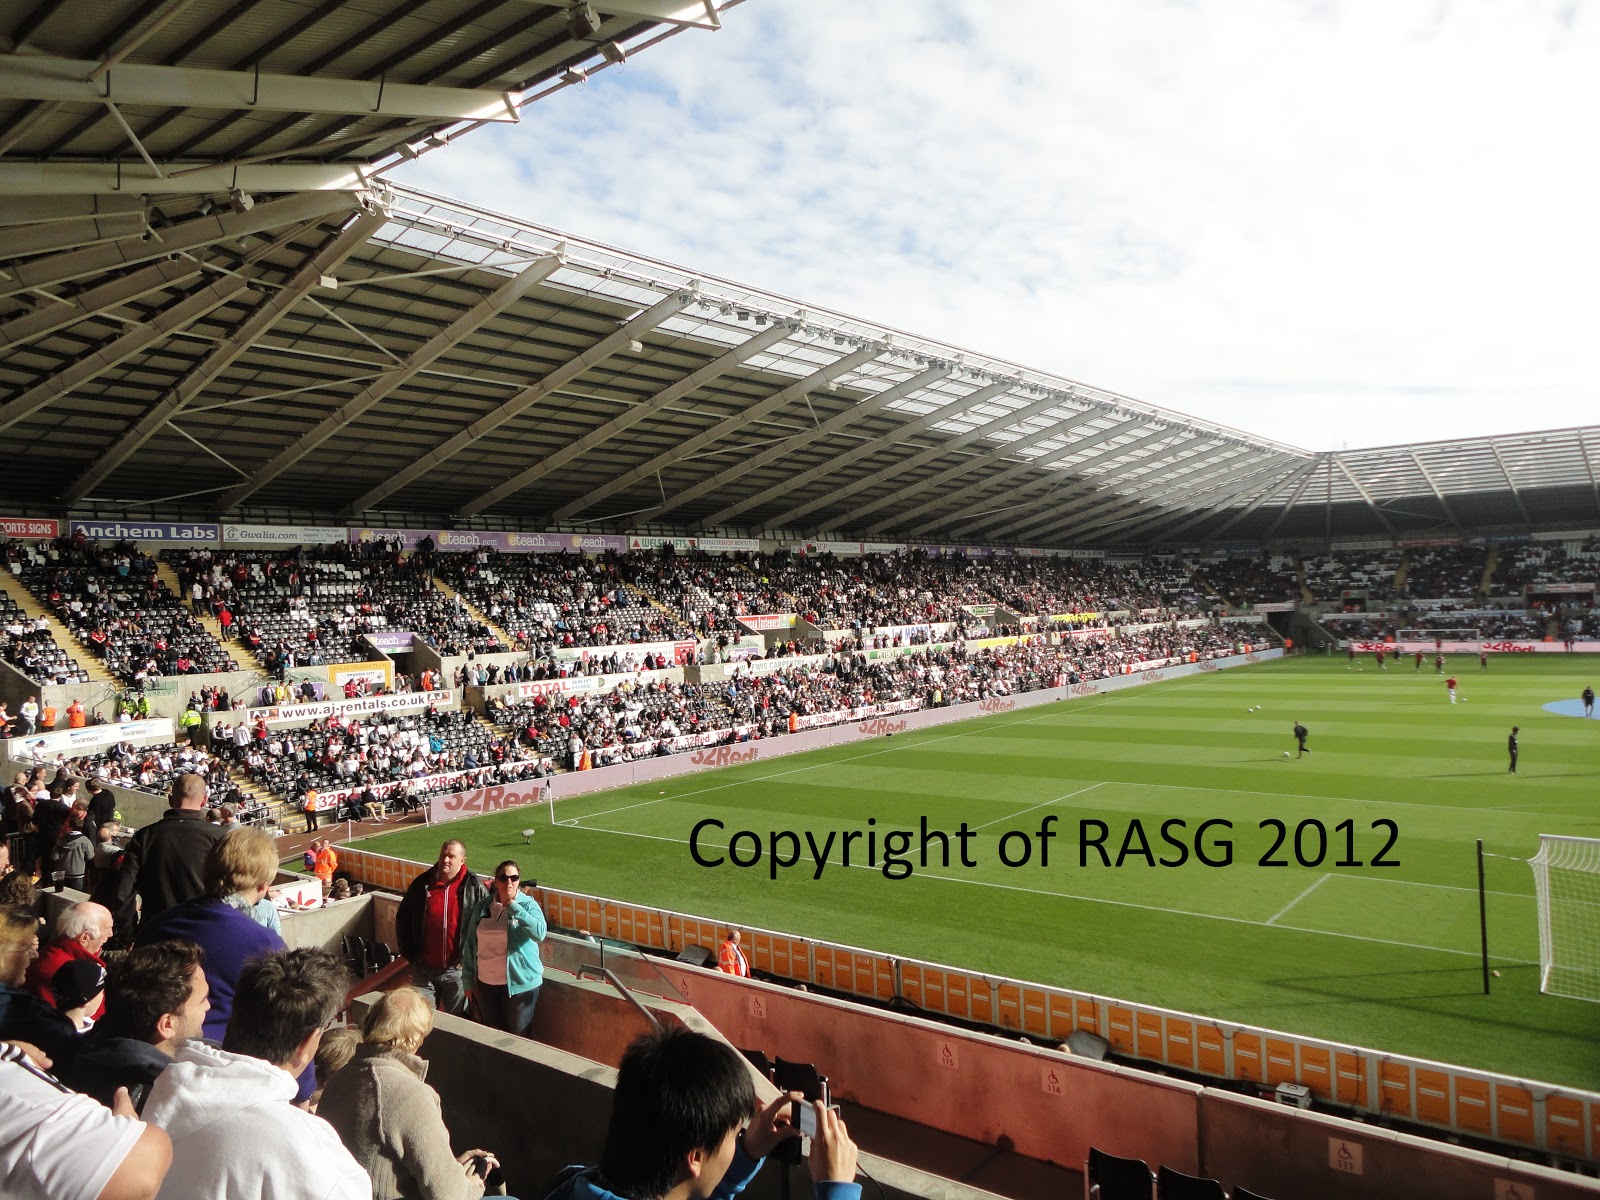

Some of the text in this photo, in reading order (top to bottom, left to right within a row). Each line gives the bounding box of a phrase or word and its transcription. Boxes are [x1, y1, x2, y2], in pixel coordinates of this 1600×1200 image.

[28, 523, 52, 534] SIGNS
[76, 524, 216, 539] Anchem Labs
[240, 530, 298, 540] Gwalia.com
[520, 681, 570, 696] TOTAL
[282, 698, 425, 719] www.aj-rentals.co.uk
[444, 786, 540, 812] 32Red
